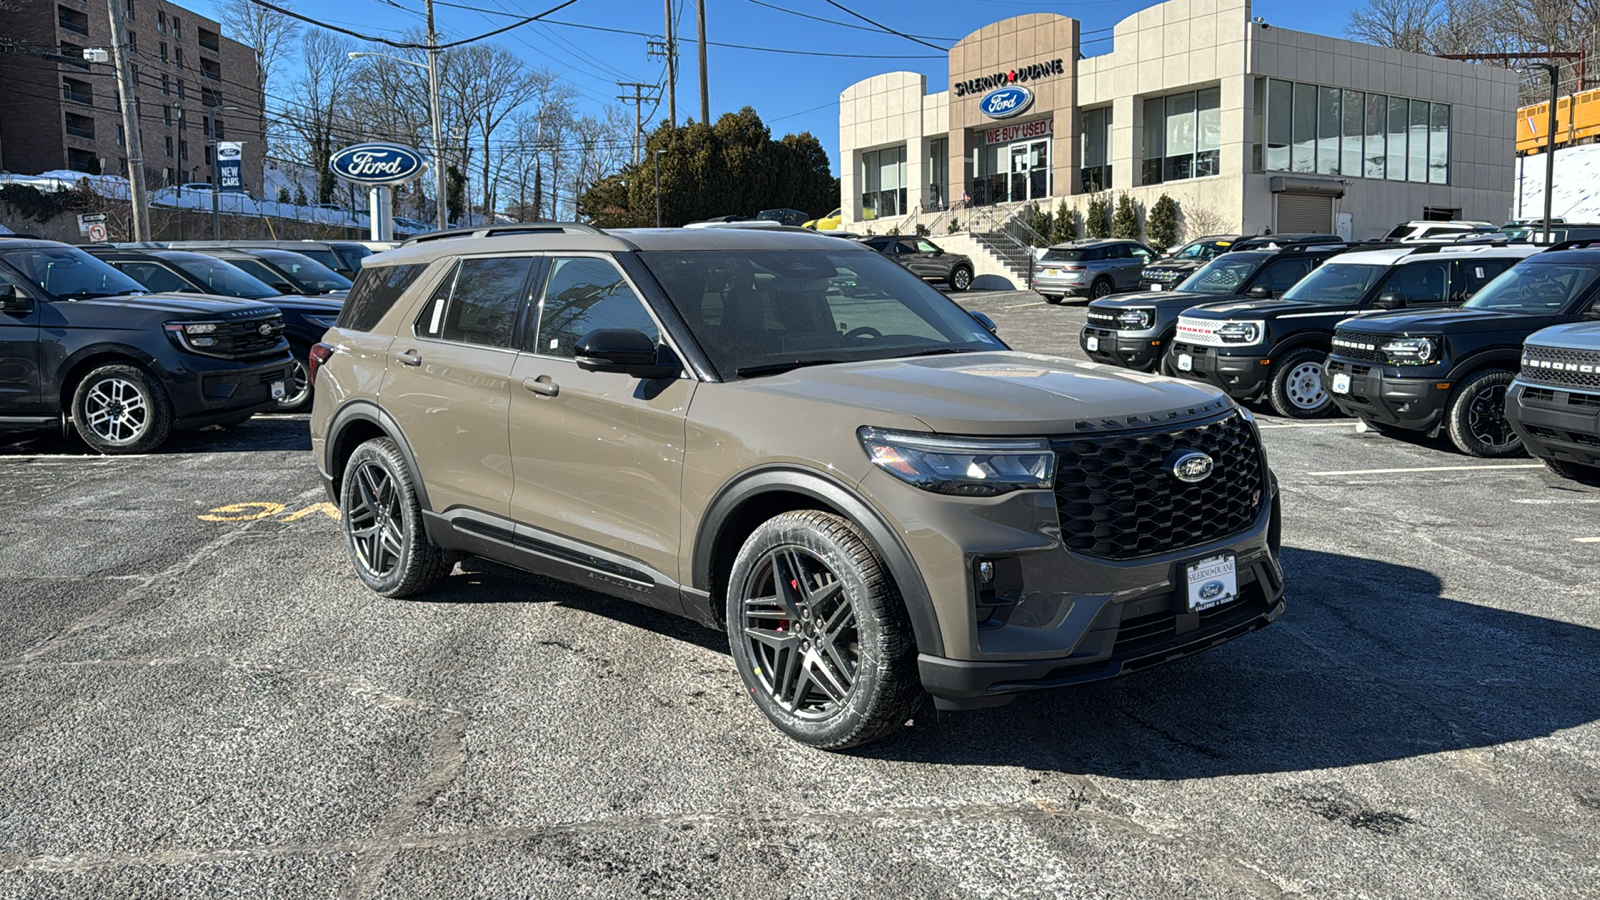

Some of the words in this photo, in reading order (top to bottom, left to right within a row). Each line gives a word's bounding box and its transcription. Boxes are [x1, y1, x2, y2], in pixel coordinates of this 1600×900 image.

[954, 72, 1007, 97] SALERNO
[1017, 59, 1064, 82] DUANE
[988, 92, 1017, 113] Ford
[986, 129, 1000, 143] WE
[1002, 125, 1021, 141] BUY
[1022, 121, 1047, 137] USED
[221, 166, 238, 178] NEW
[348, 151, 402, 175] Ford
[221, 177, 240, 187] CARS
[1178, 326, 1211, 334] BRONCO
[1333, 340, 1375, 350] BRONCO
[1074, 401, 1223, 429] EXPLORER
[1188, 569, 1213, 581] SALERNO
[1214, 562, 1234, 574] DUANE
